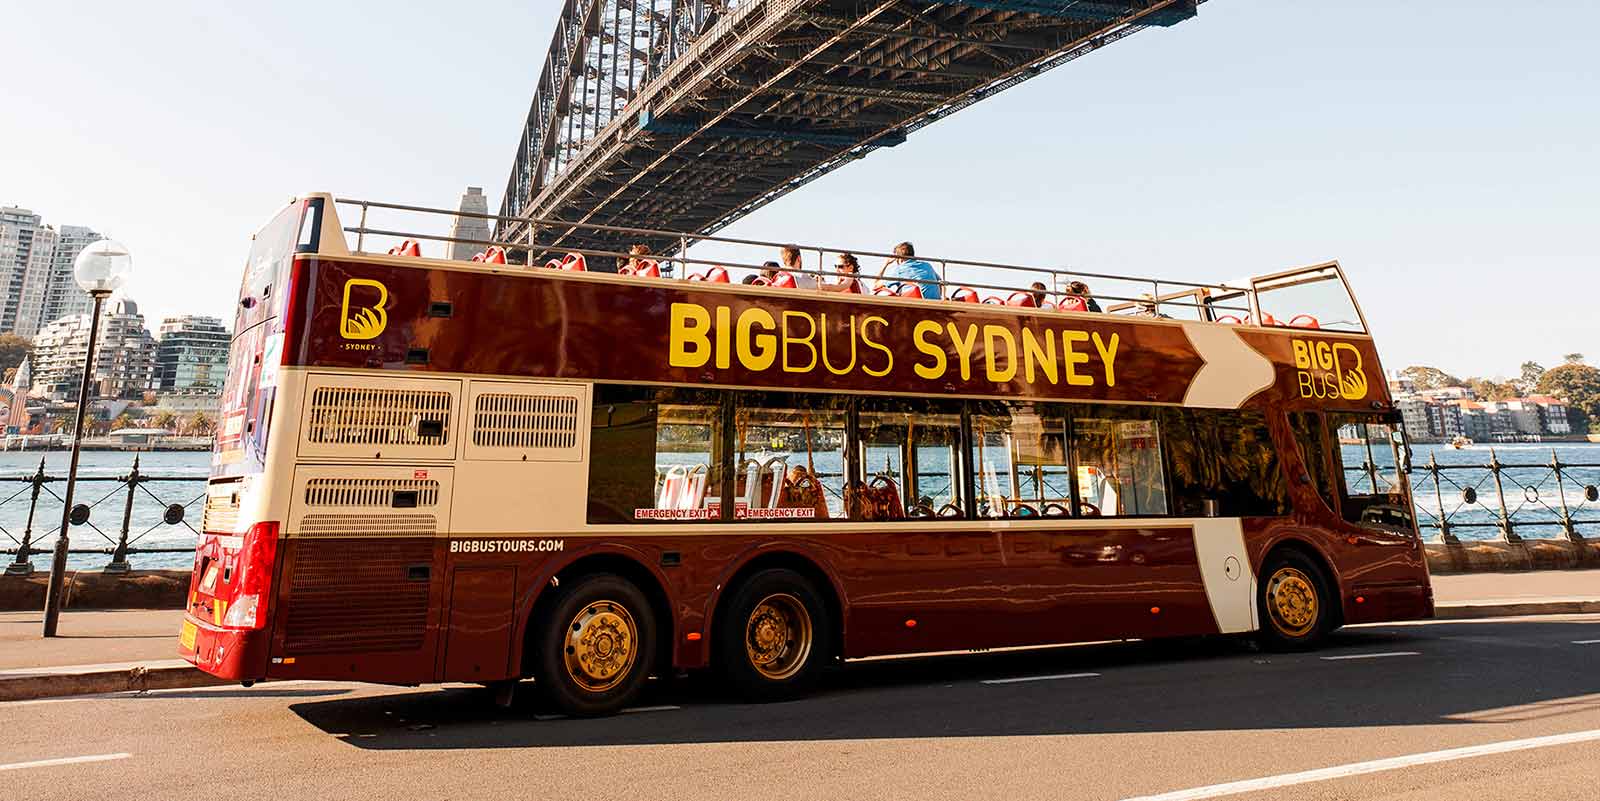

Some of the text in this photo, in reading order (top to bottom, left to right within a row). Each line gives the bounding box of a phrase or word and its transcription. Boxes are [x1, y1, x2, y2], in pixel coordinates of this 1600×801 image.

[345, 343, 376, 351] SYDNEY
[913, 319, 1120, 387] SYDNEY
[1292, 339, 1333, 370] BIG
[1297, 371, 1340, 399] BUS
[636, 509, 708, 518] EMERGENCY EXIT
[748, 508, 814, 518] EMERGENCY EXIT
[450, 539, 564, 553] BIGBUSTOURS.COM
